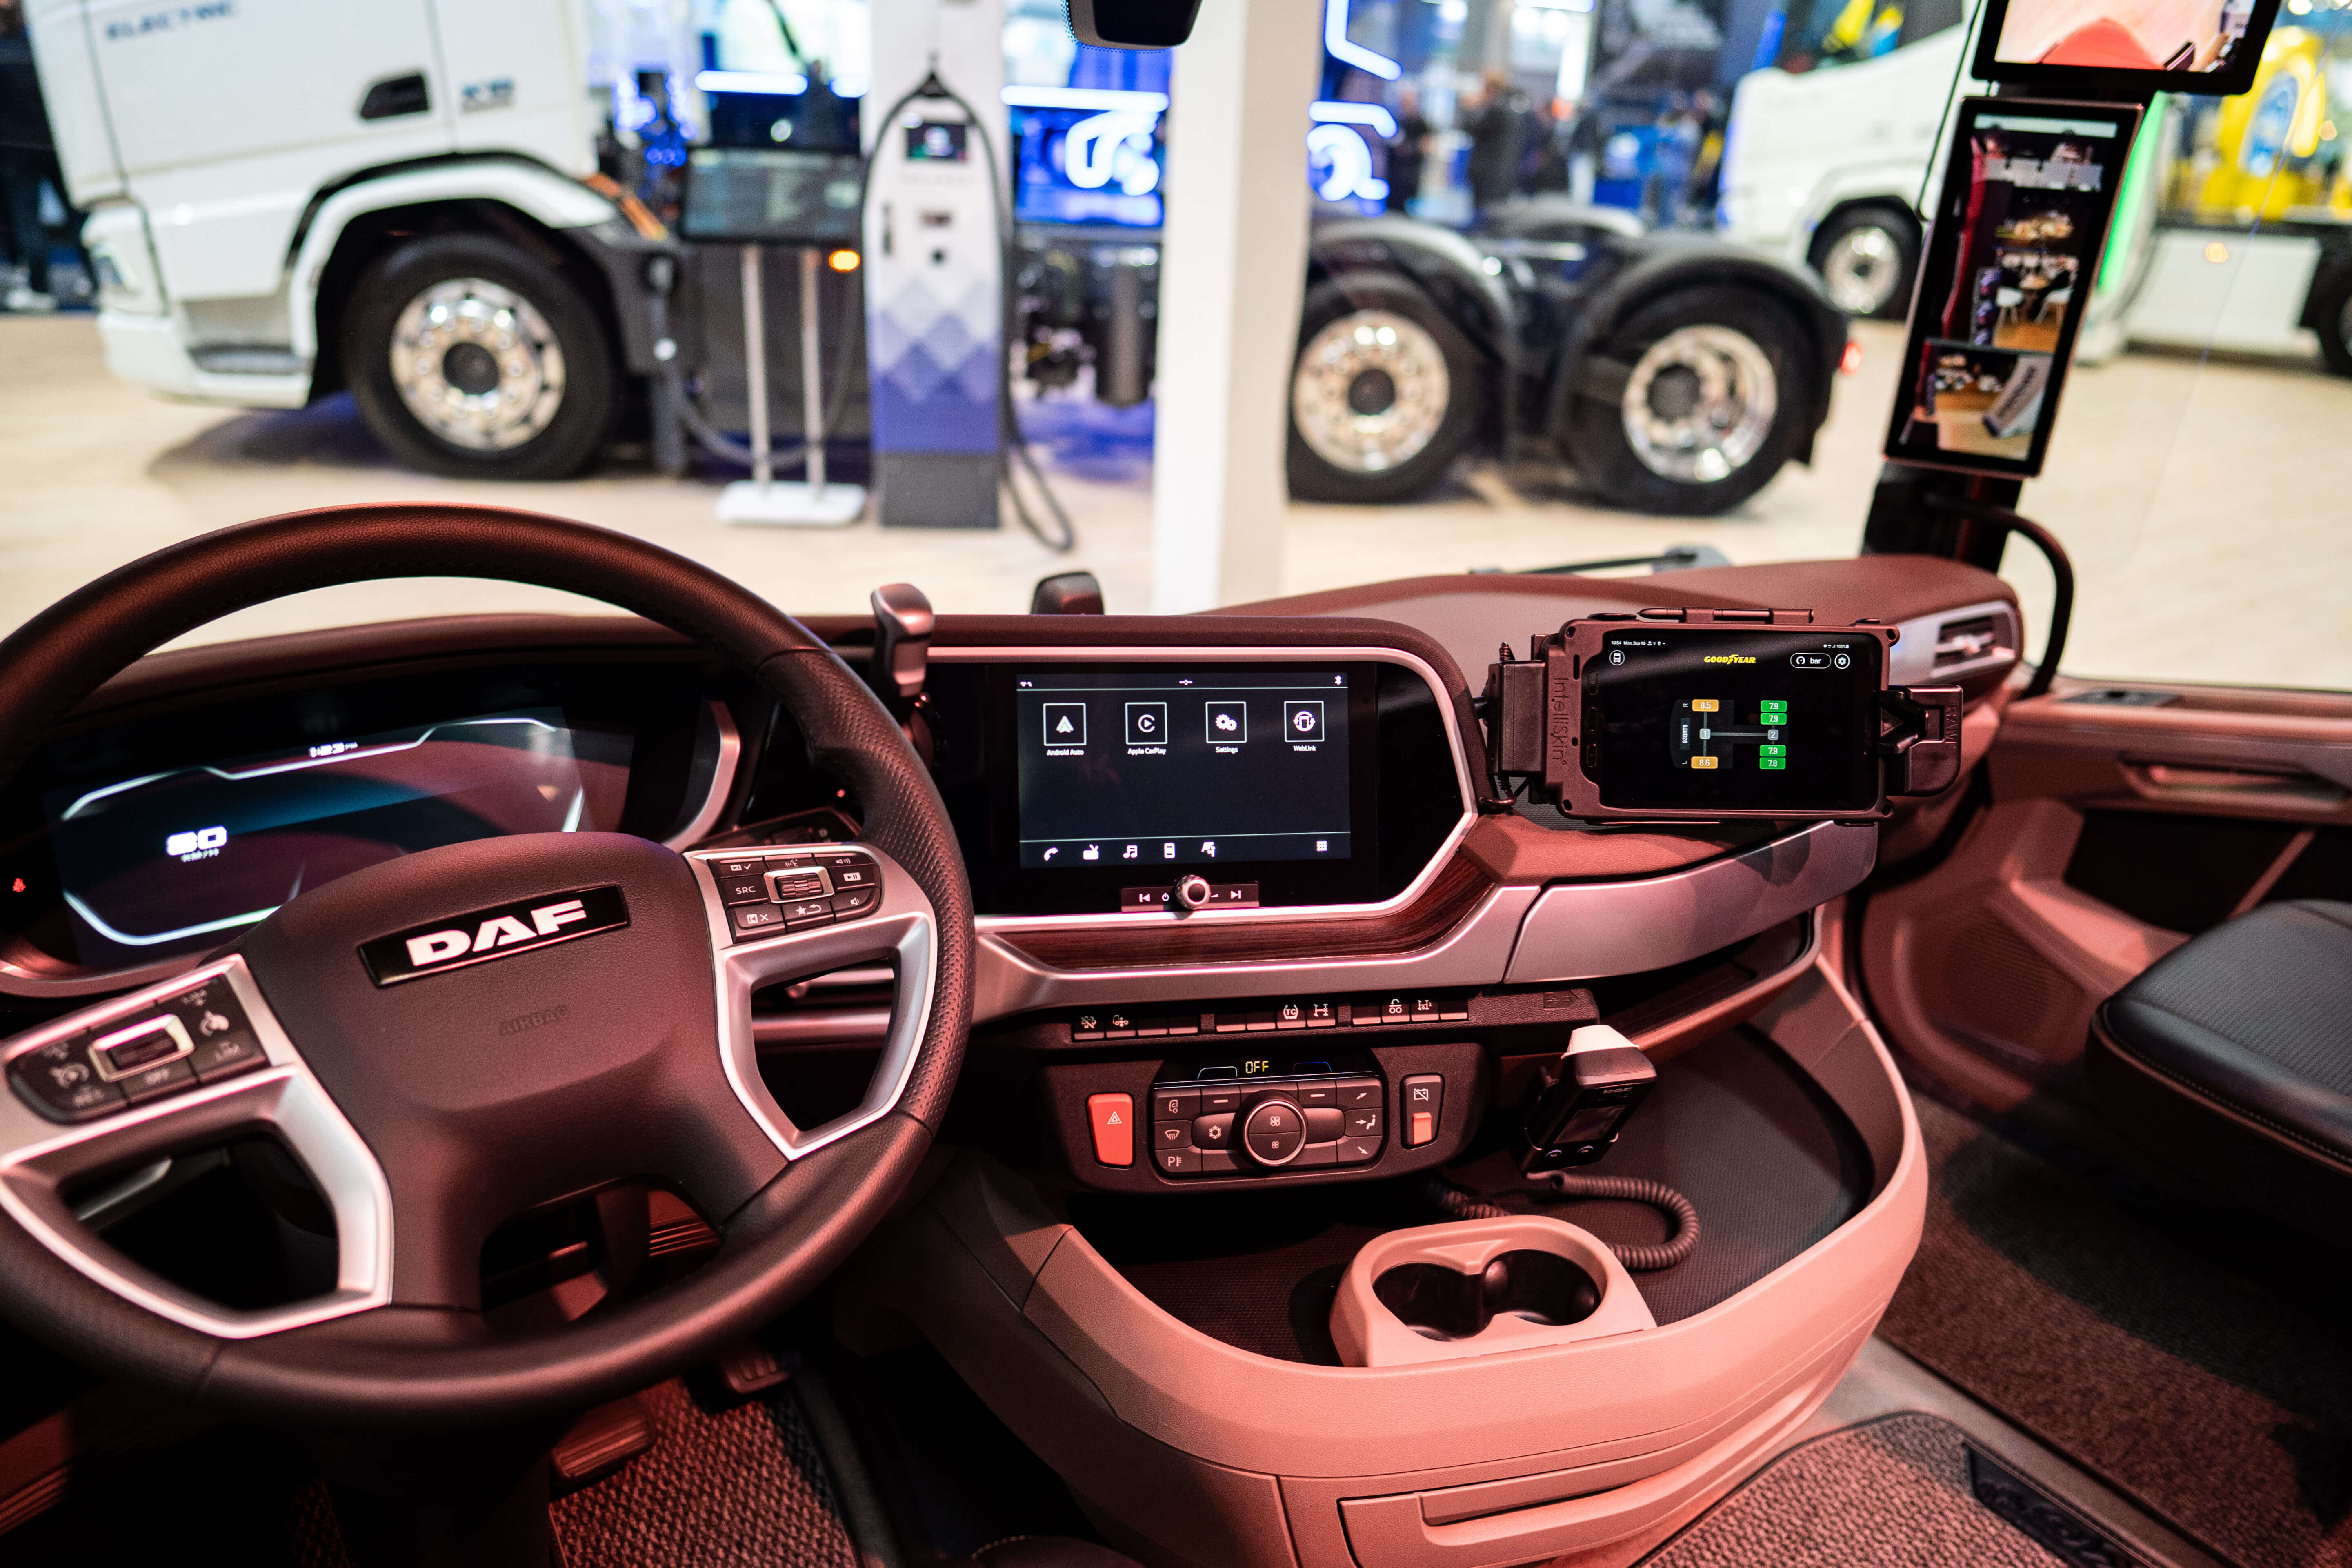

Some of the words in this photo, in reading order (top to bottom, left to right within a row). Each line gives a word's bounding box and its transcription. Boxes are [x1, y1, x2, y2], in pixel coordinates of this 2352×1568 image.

[1704, 654, 1756, 665] GOODYEAR
[736, 886, 756, 894] SRC
[406, 899, 587, 966] DAF
[1245, 1061, 1269, 1074] OFF
[1168, 1156, 1176, 1167] P
